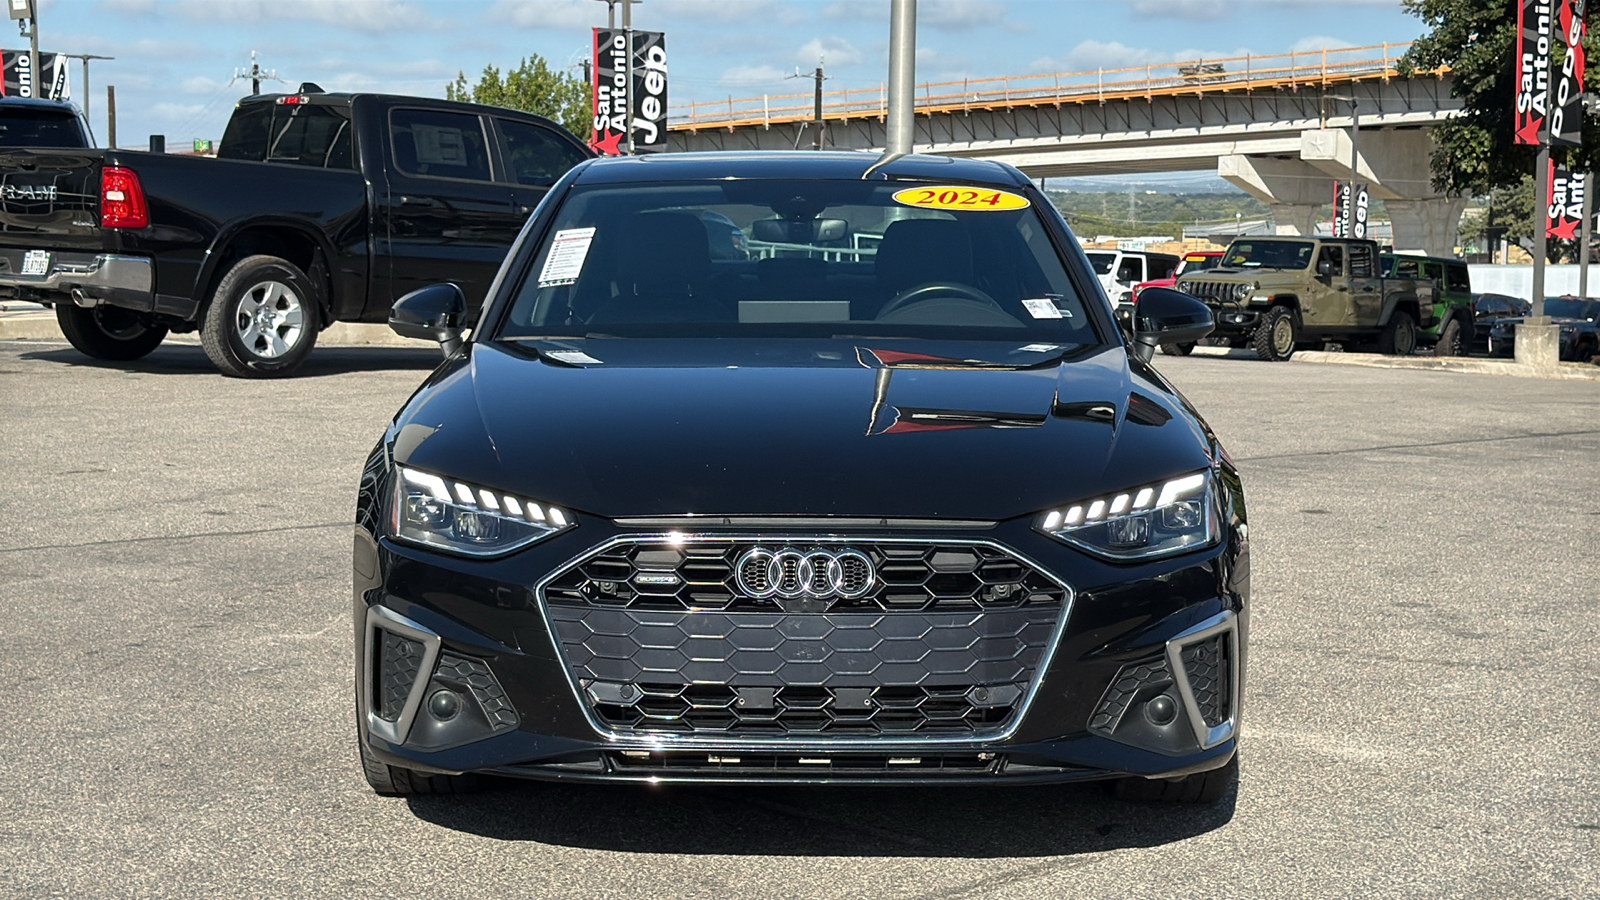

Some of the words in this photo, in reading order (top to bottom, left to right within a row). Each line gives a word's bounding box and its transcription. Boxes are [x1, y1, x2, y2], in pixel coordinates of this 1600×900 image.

[1532, 0, 1550, 116] Antoni
[610, 35, 627, 132] Antonio
[631, 45, 668, 144] Jeep
[1517, 53, 1533, 114] San
[594, 85, 610, 131] San
[0, 185, 57, 200] RAM
[916, 190, 1002, 206] 2024
[1354, 191, 1368, 238] eep
[1548, 178, 1567, 219] San
